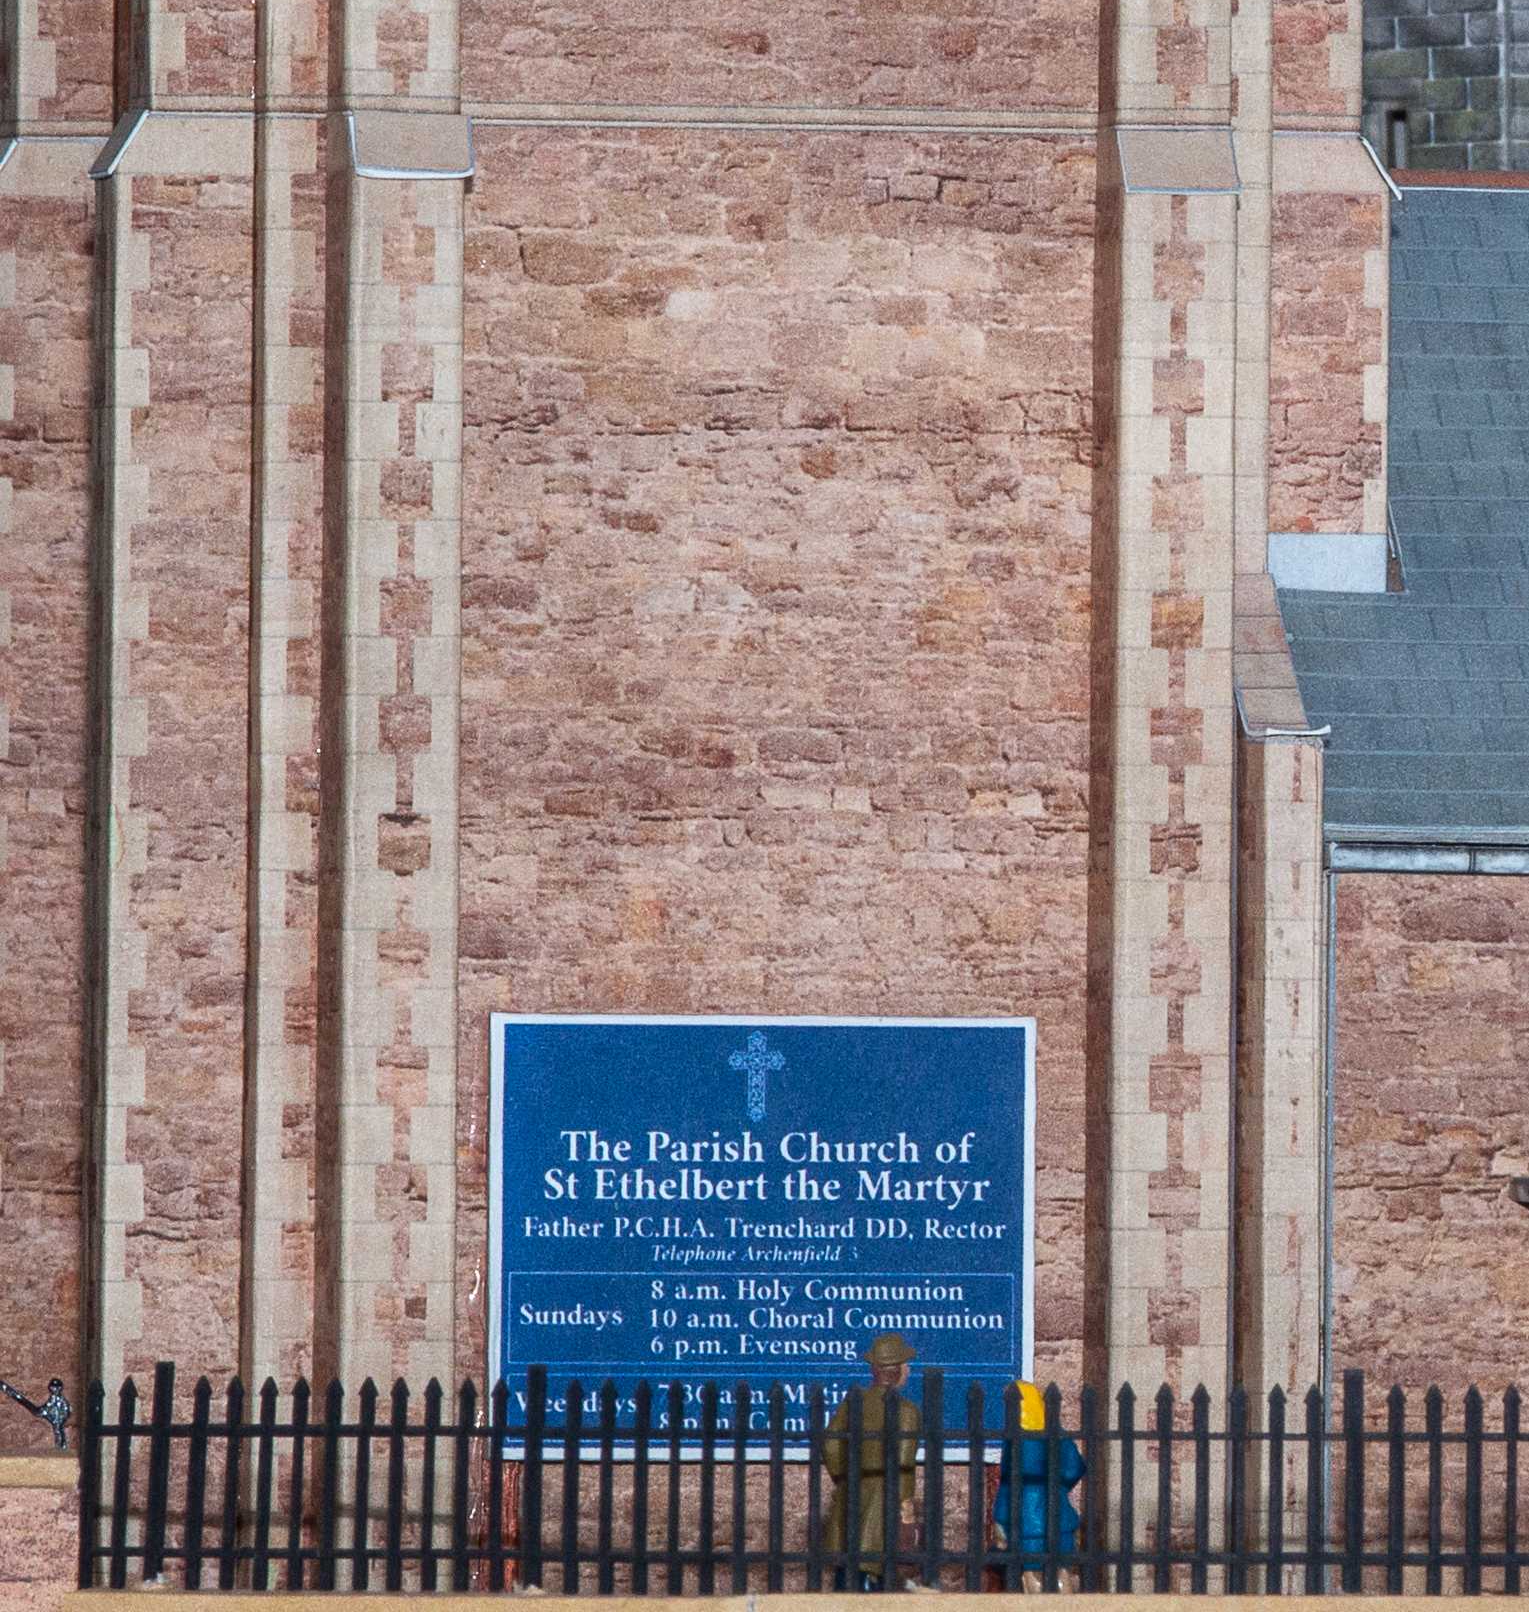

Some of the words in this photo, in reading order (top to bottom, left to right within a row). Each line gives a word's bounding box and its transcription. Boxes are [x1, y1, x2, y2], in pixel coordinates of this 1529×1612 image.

[560, 1129, 631, 1162] The
[646, 1131, 765, 1163] Parish
[780, 1131, 919, 1163] Church
[935, 1132, 976, 1164] of
[544, 1168, 579, 1200] St
[595, 1168, 768, 1201] Ethelbert
[783, 1169, 841, 1201] the
[856, 1170, 990, 1210] Martyr
[524, 1216, 604, 1237] Father
[614, 1217, 715, 1238] P.C.H.A.
[724, 1217, 854, 1238] Trenchard
[866, 1218, 914, 1240] DD,
[925, 1218, 1007, 1239] Rector
[652, 1244, 736, 1265] Telephone
[741, 1245, 842, 1264] Archenfield
[651, 1280, 664, 1300] 8
[675, 1285, 727, 1300] a.m.
[737, 1279, 794, 1306] Holy
[805, 1279, 964, 1301] Communion
[520, 1303, 623, 1331] Sundays
[650, 1308, 677, 1328] 10
[687, 1314, 739, 1329] a.m.
[749, 1308, 834, 1329] Choral
[844, 1308, 1004, 1330] Communion
[651, 1336, 664, 1355] 6
[675, 1339, 729, 1360] p.m.
[740, 1334, 857, 1361] Evensong
[658, 1384, 706, 1403] 730
